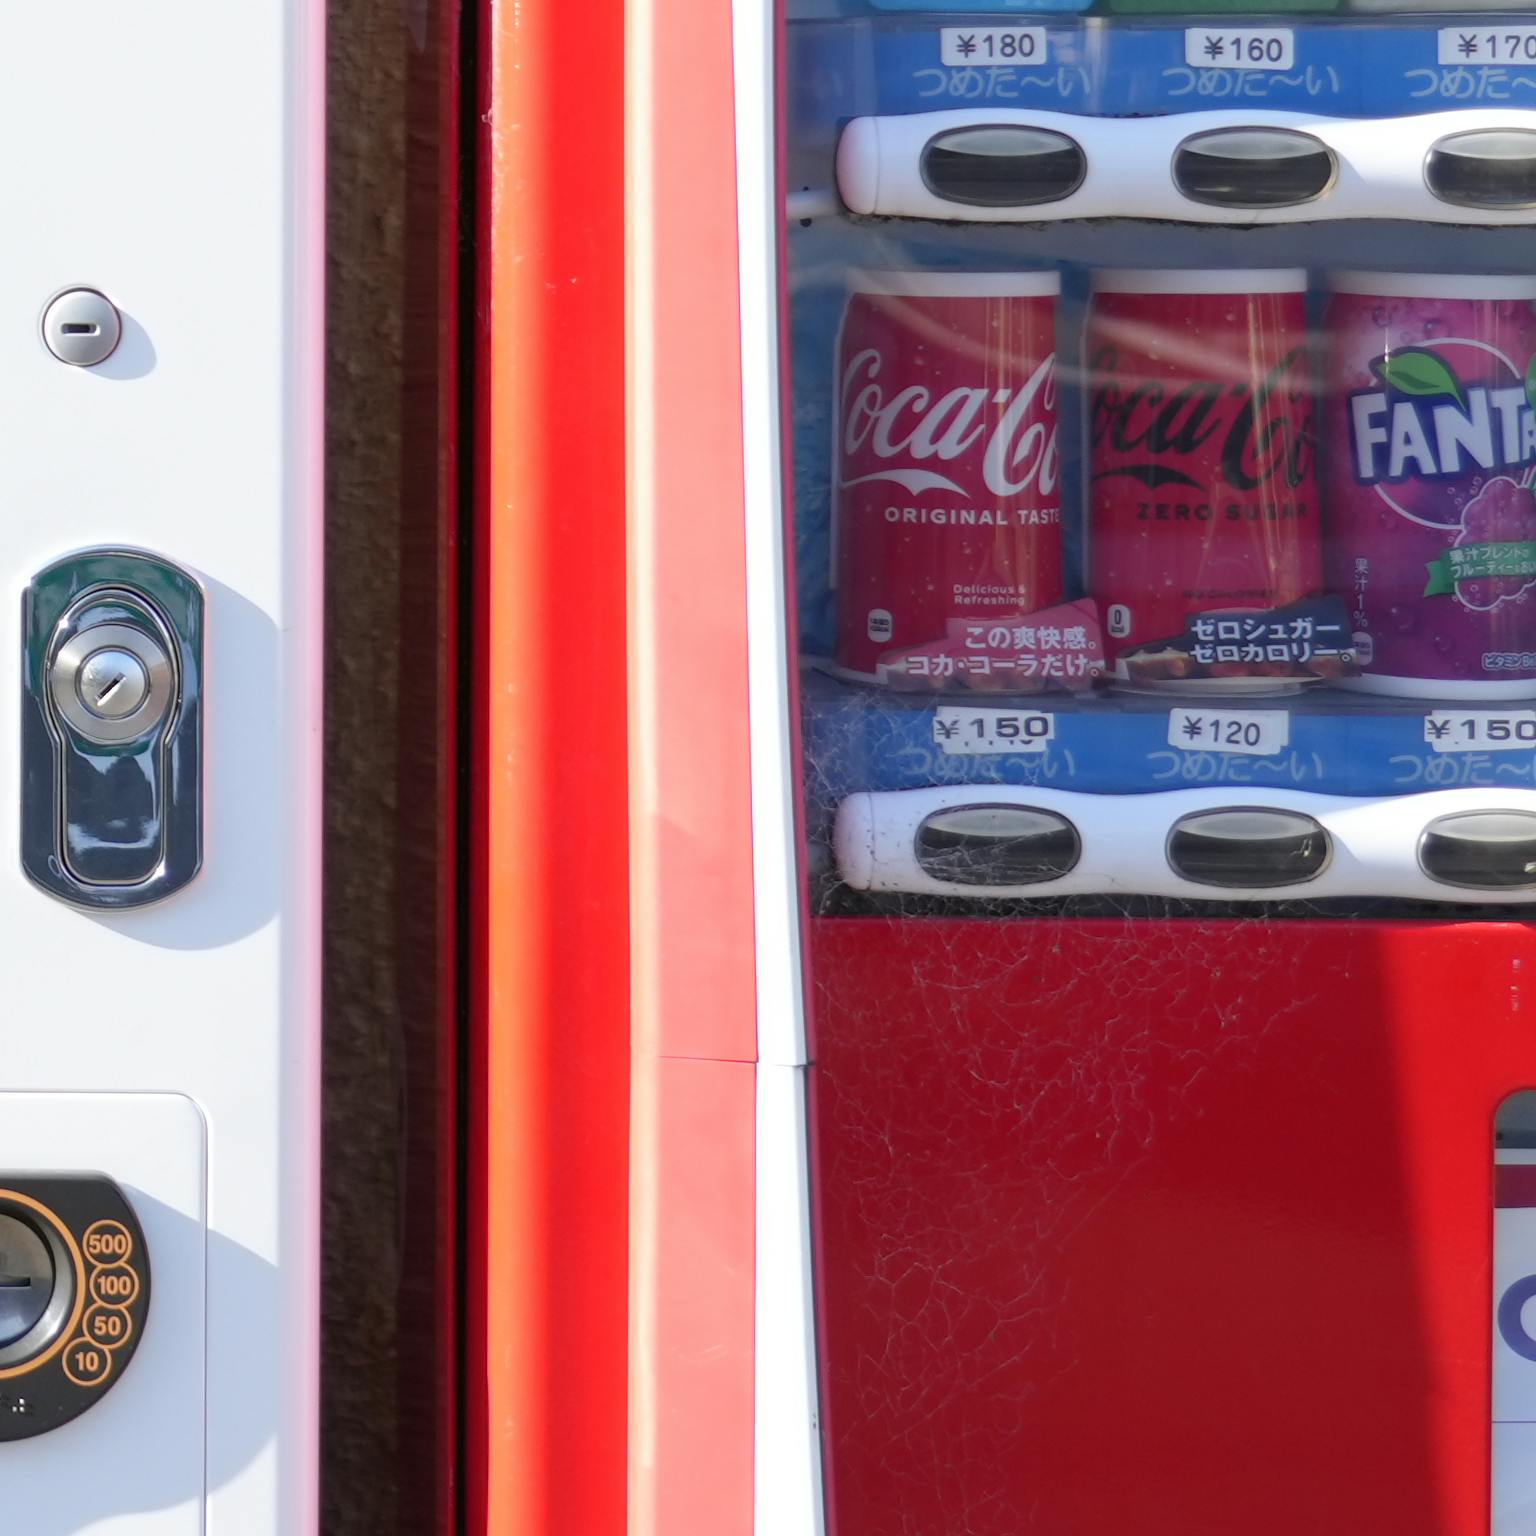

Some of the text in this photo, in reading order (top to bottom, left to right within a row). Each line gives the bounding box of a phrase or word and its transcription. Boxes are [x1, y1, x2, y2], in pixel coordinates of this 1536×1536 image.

[956, 33, 1037, 60] ¥180
[1203, 37, 1285, 64] ¥160
[964, 626, 1100, 652] この爽快感。
[933, 715, 1051, 740] ¥150
[1181, 716, 1263, 747] ¥120
[88, 1233, 129, 1254] 500
[97, 1275, 132, 1296] 100
[93, 1316, 122, 1336] 50
[74, 1351, 100, 1371] 10
